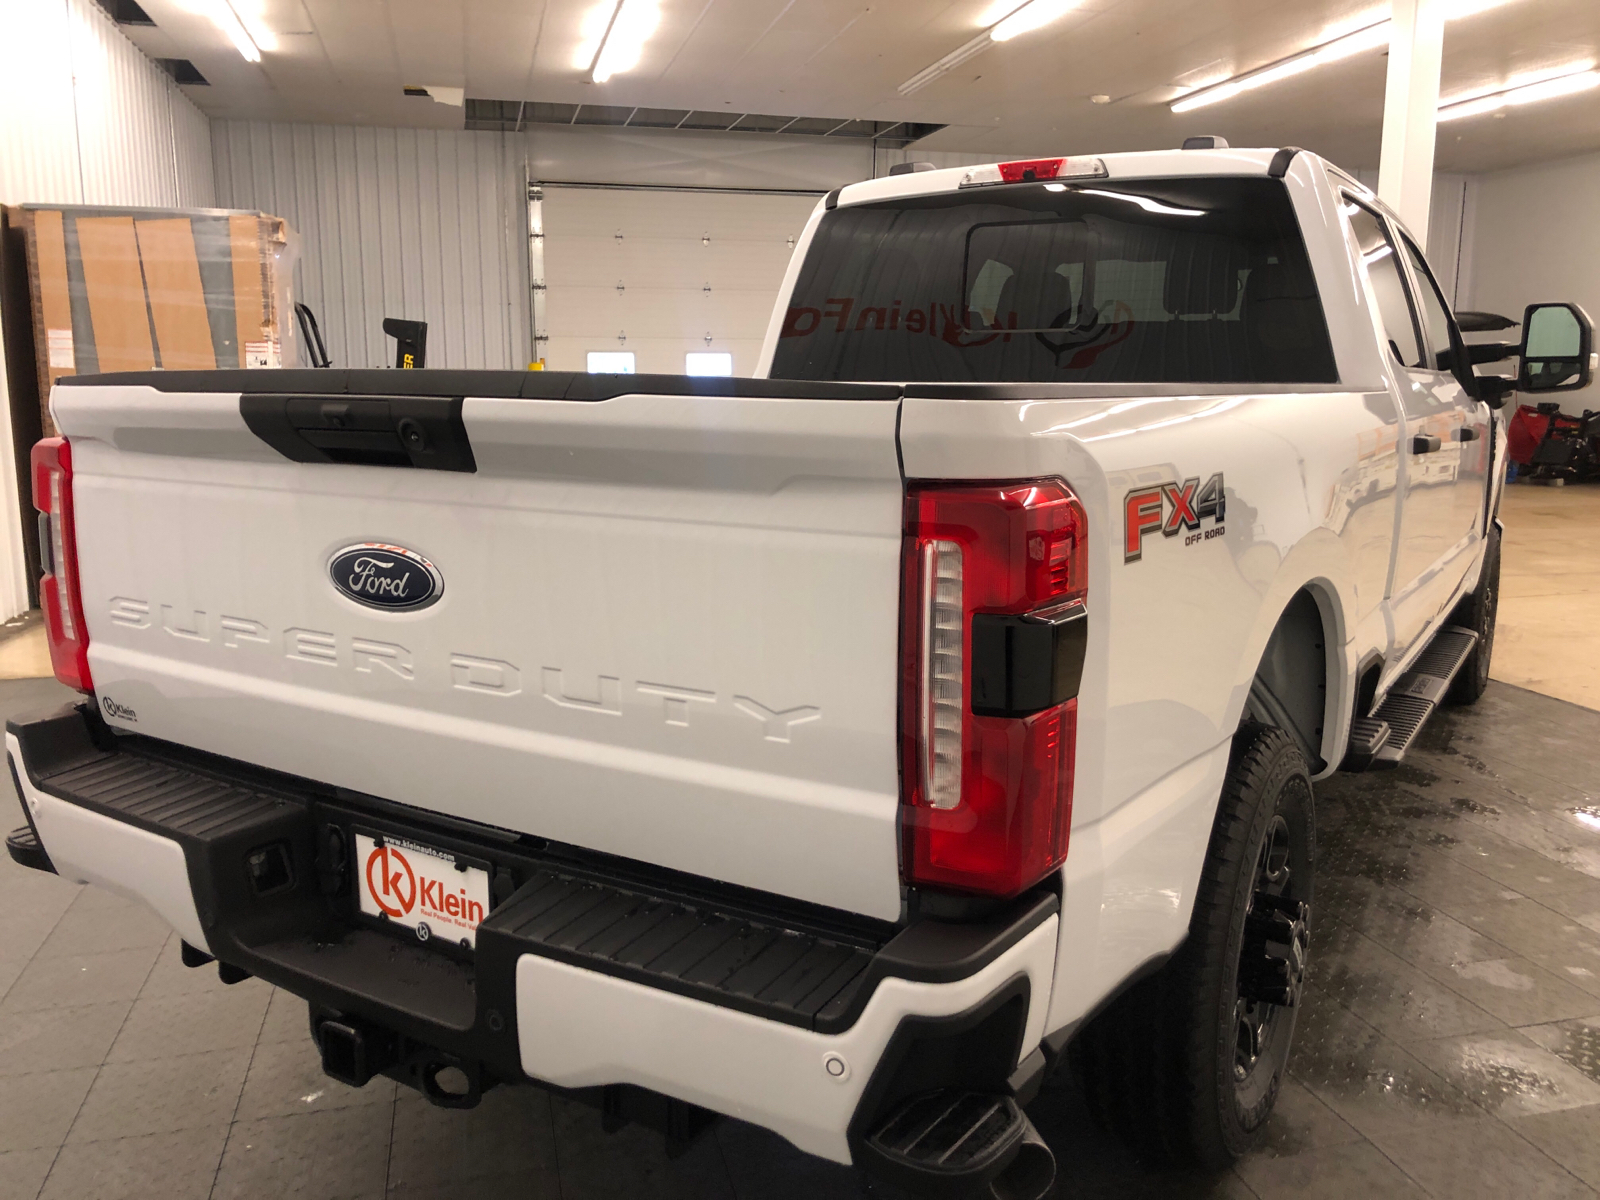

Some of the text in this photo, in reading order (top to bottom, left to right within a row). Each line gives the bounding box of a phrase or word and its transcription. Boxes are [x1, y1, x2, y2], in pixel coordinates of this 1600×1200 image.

[1123, 471, 1226, 565] FX4
[1185, 526, 1226, 547] OFF ROAD
[348, 556, 410, 597] Ford
[108, 596, 821, 743] SUPER DUTY
[383, 836, 455, 862] www.kleinauto.com
[419, 876, 484, 923] Klein
[420, 908, 432, 917] Real
[454, 919, 467, 929] Real
